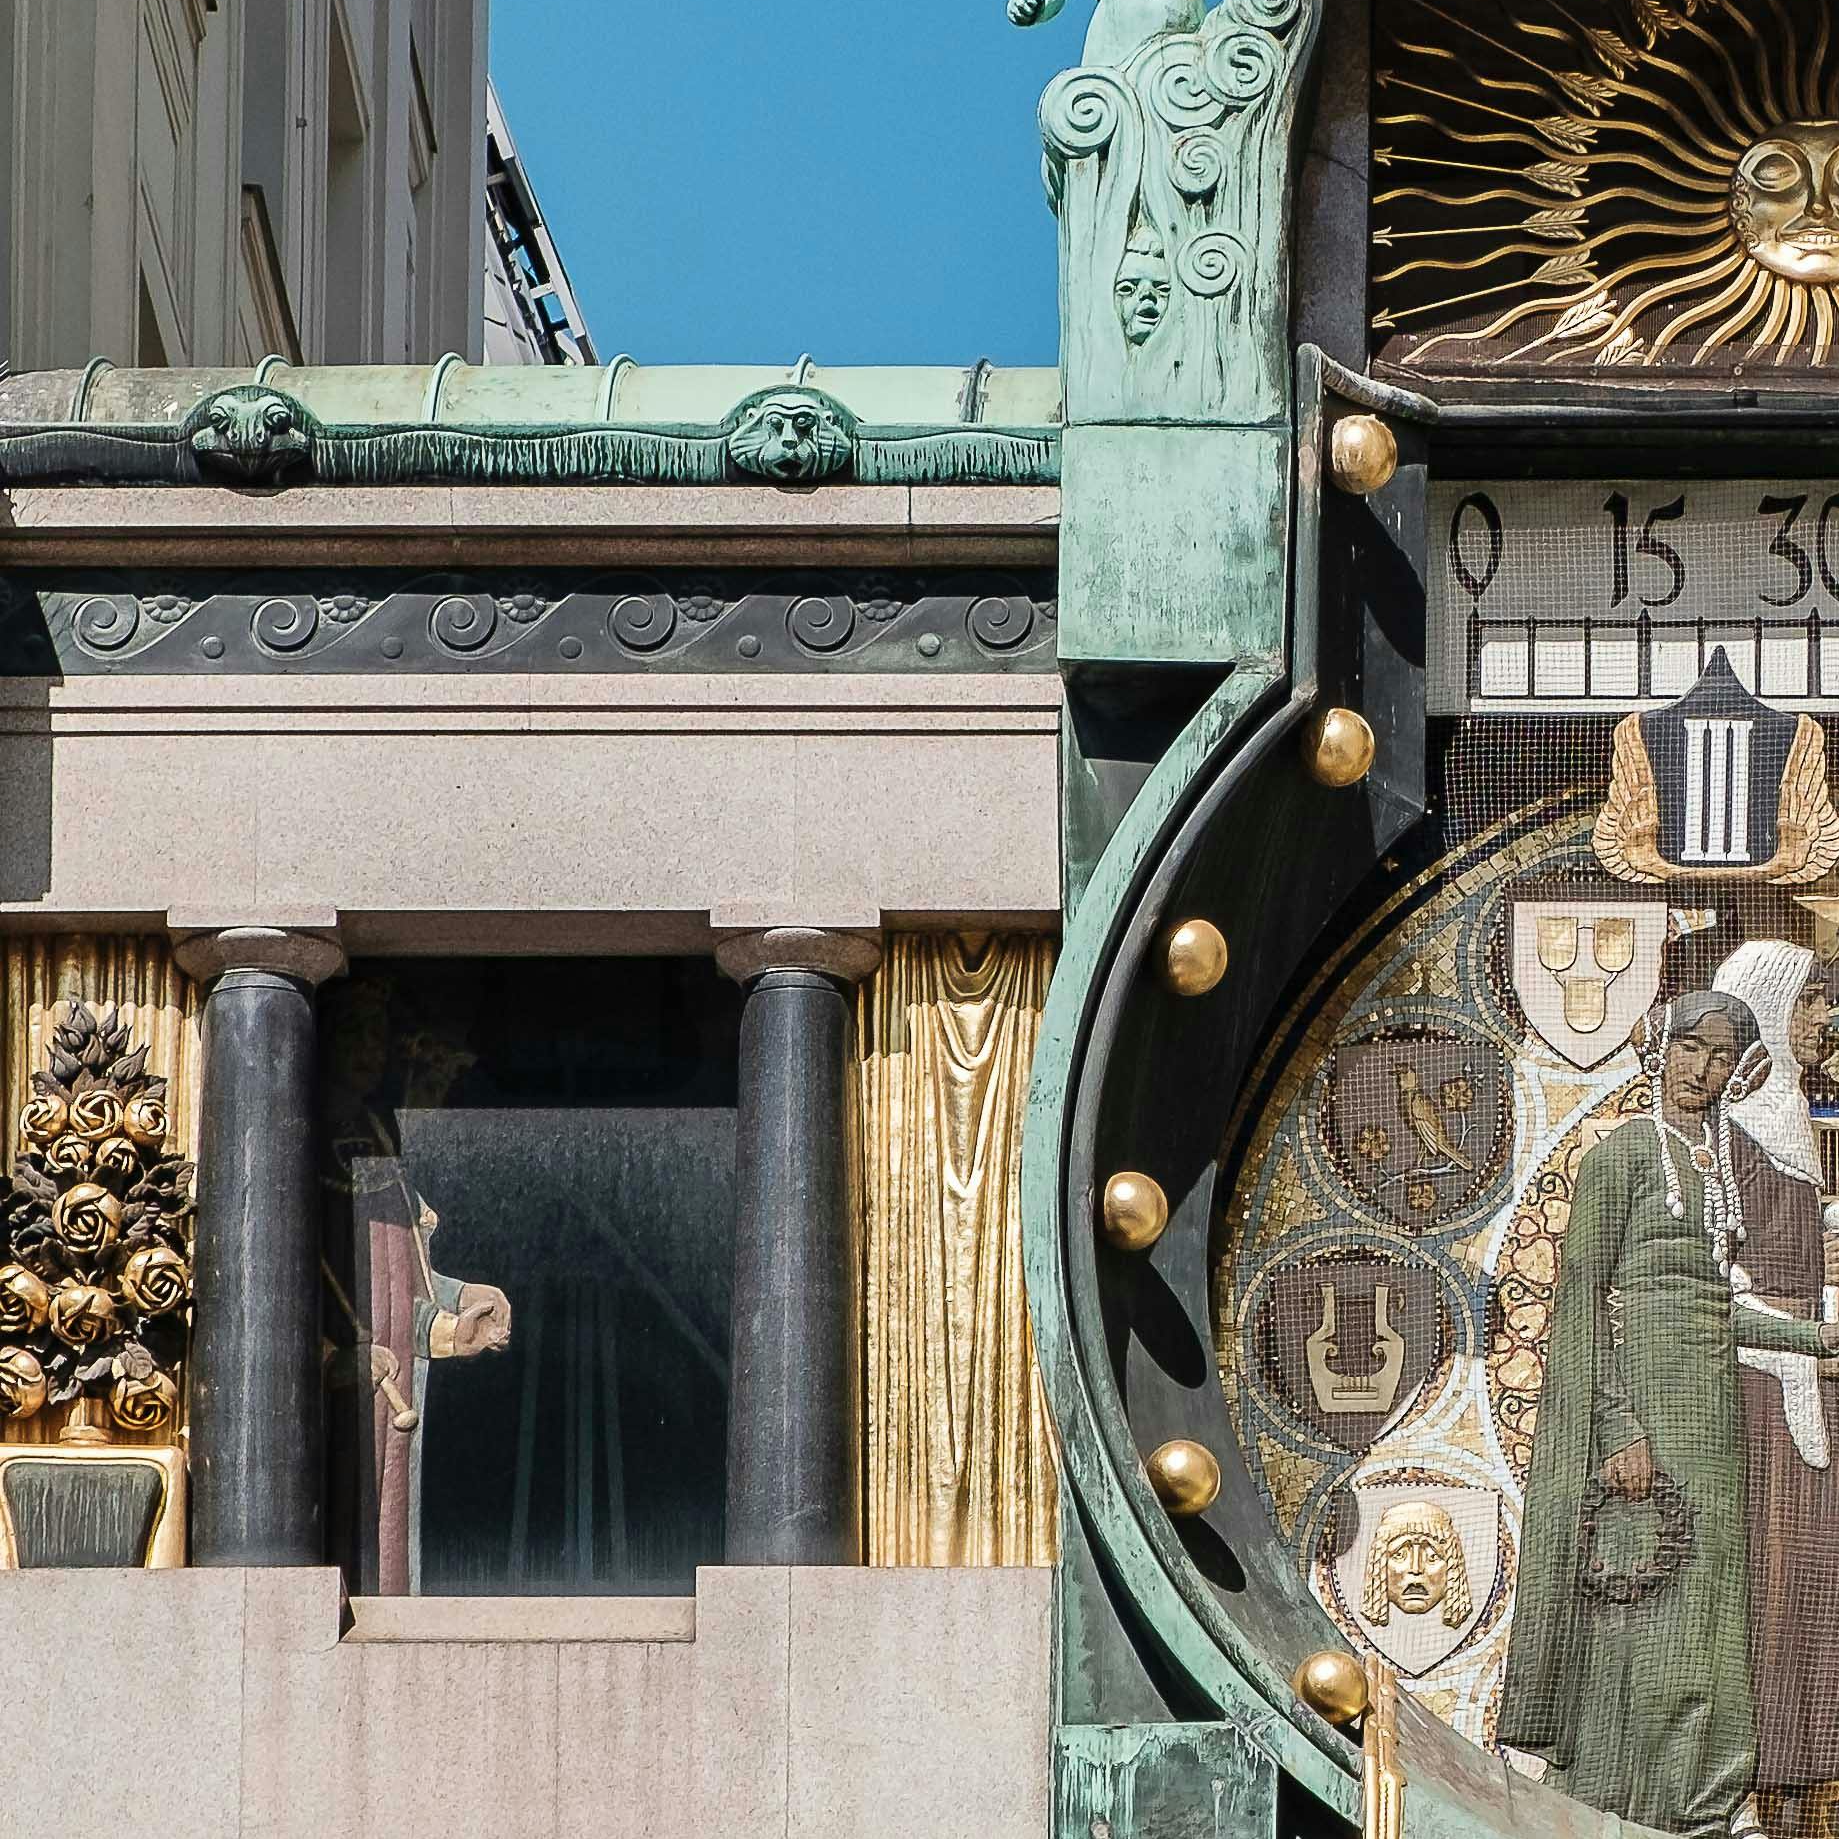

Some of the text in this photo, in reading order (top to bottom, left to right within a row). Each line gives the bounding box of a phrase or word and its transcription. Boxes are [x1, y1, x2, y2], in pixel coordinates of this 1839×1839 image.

[1448, 491, 1503, 602] 0
[1602, 489, 1686, 608] 15
[1681, 717, 1754, 862] III
